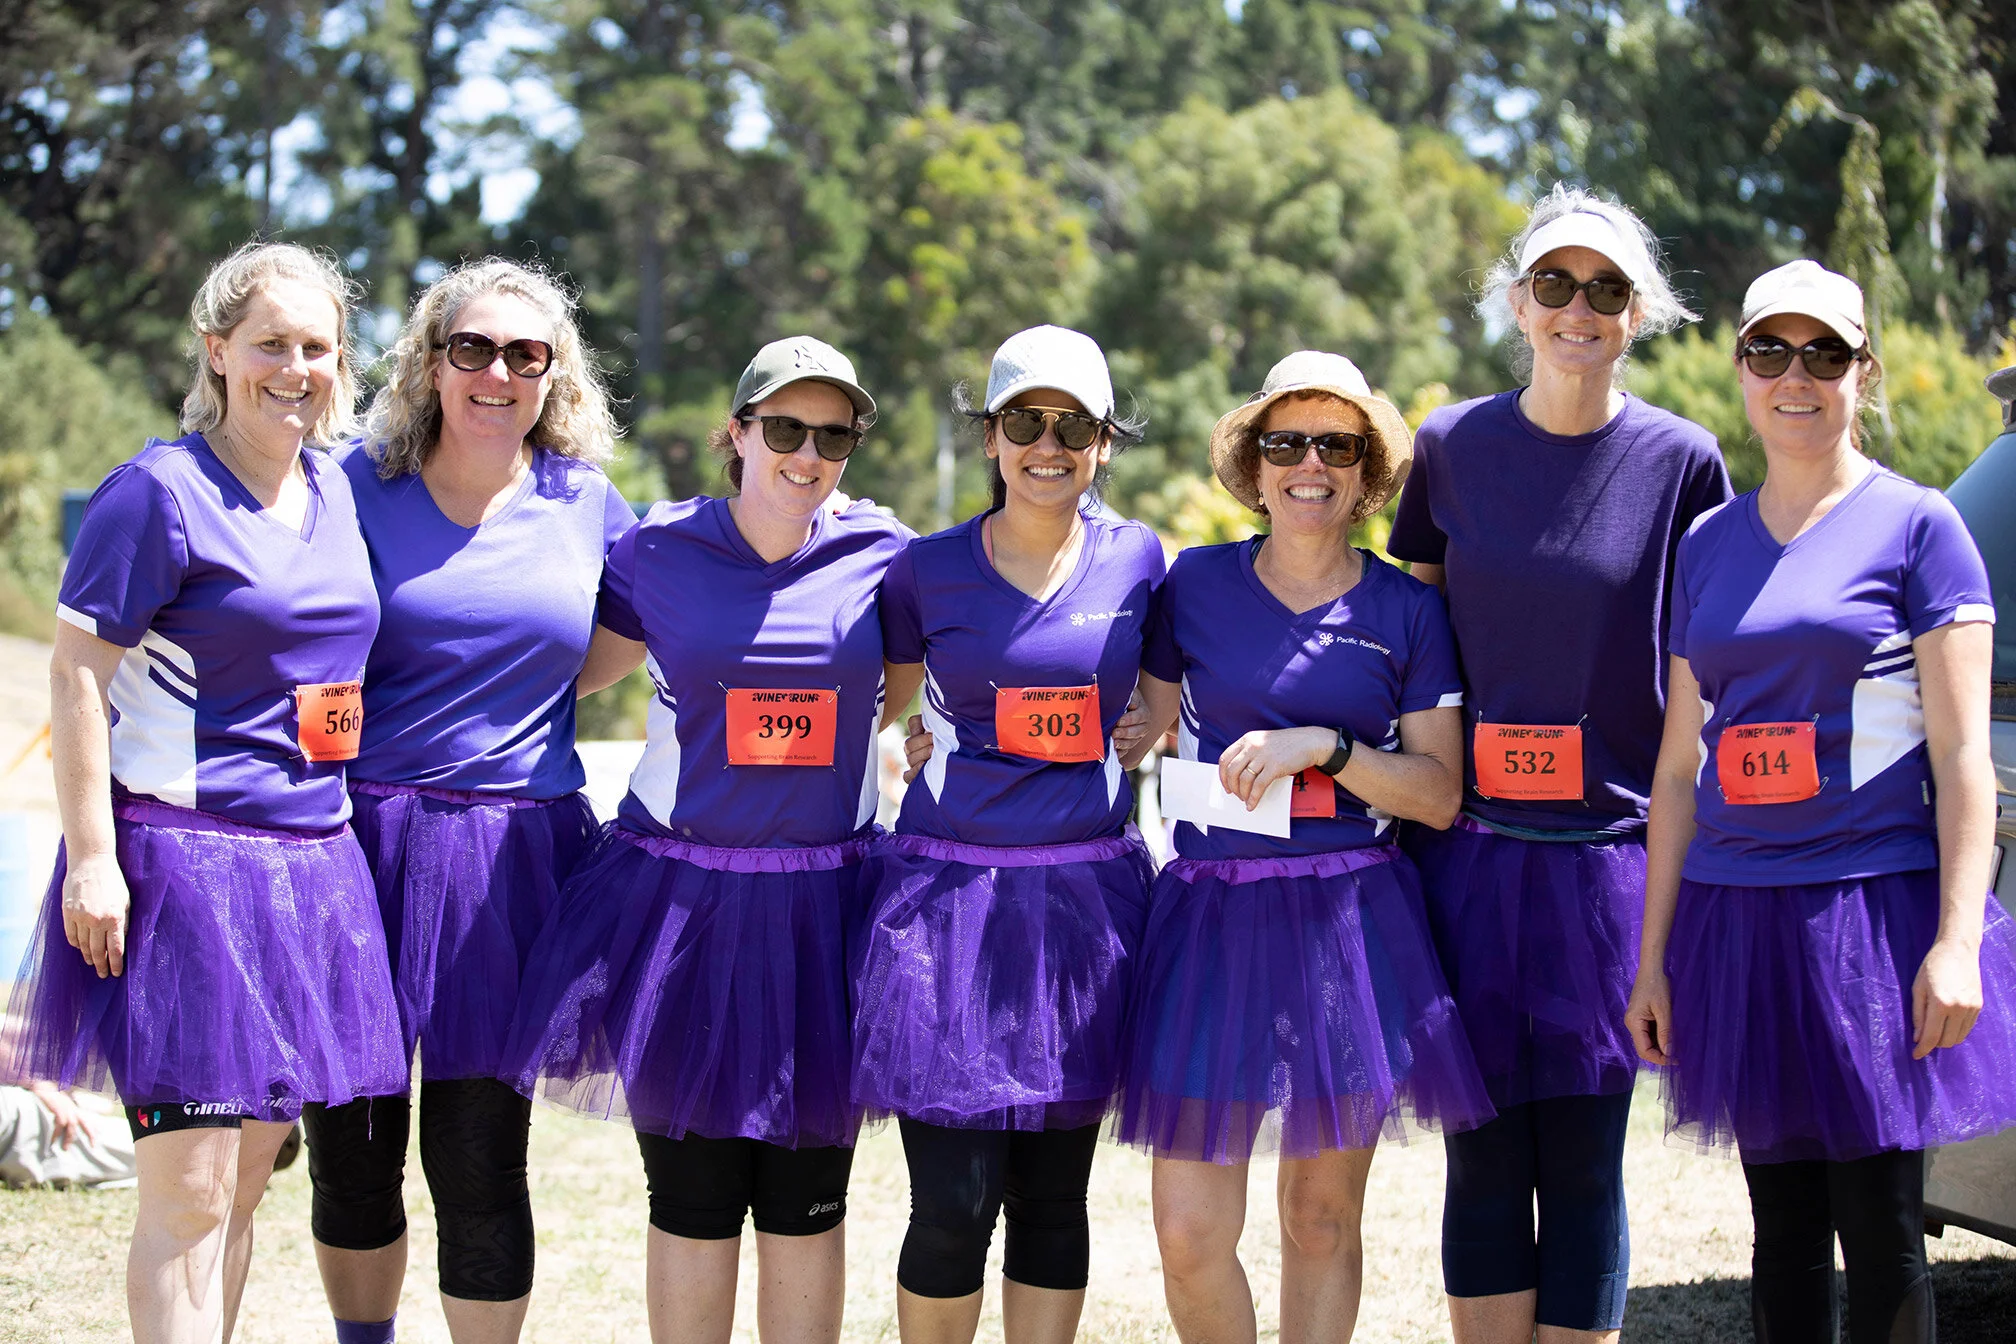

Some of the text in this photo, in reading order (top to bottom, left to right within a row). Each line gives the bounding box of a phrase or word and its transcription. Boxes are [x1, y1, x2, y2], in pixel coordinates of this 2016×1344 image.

[1336, 636, 1392, 655] Pacific Radiology
[792, 693, 815, 703] RUN
[1062, 690, 1086, 701] RUN
[325, 707, 360, 735] 566
[758, 714, 812, 739] 399
[1027, 713, 1081, 737] 303
[1536, 729, 1561, 739] RUN
[1504, 750, 1556, 774] 532
[1742, 750, 1791, 776] 614
[820, 1202, 839, 1213] asics
